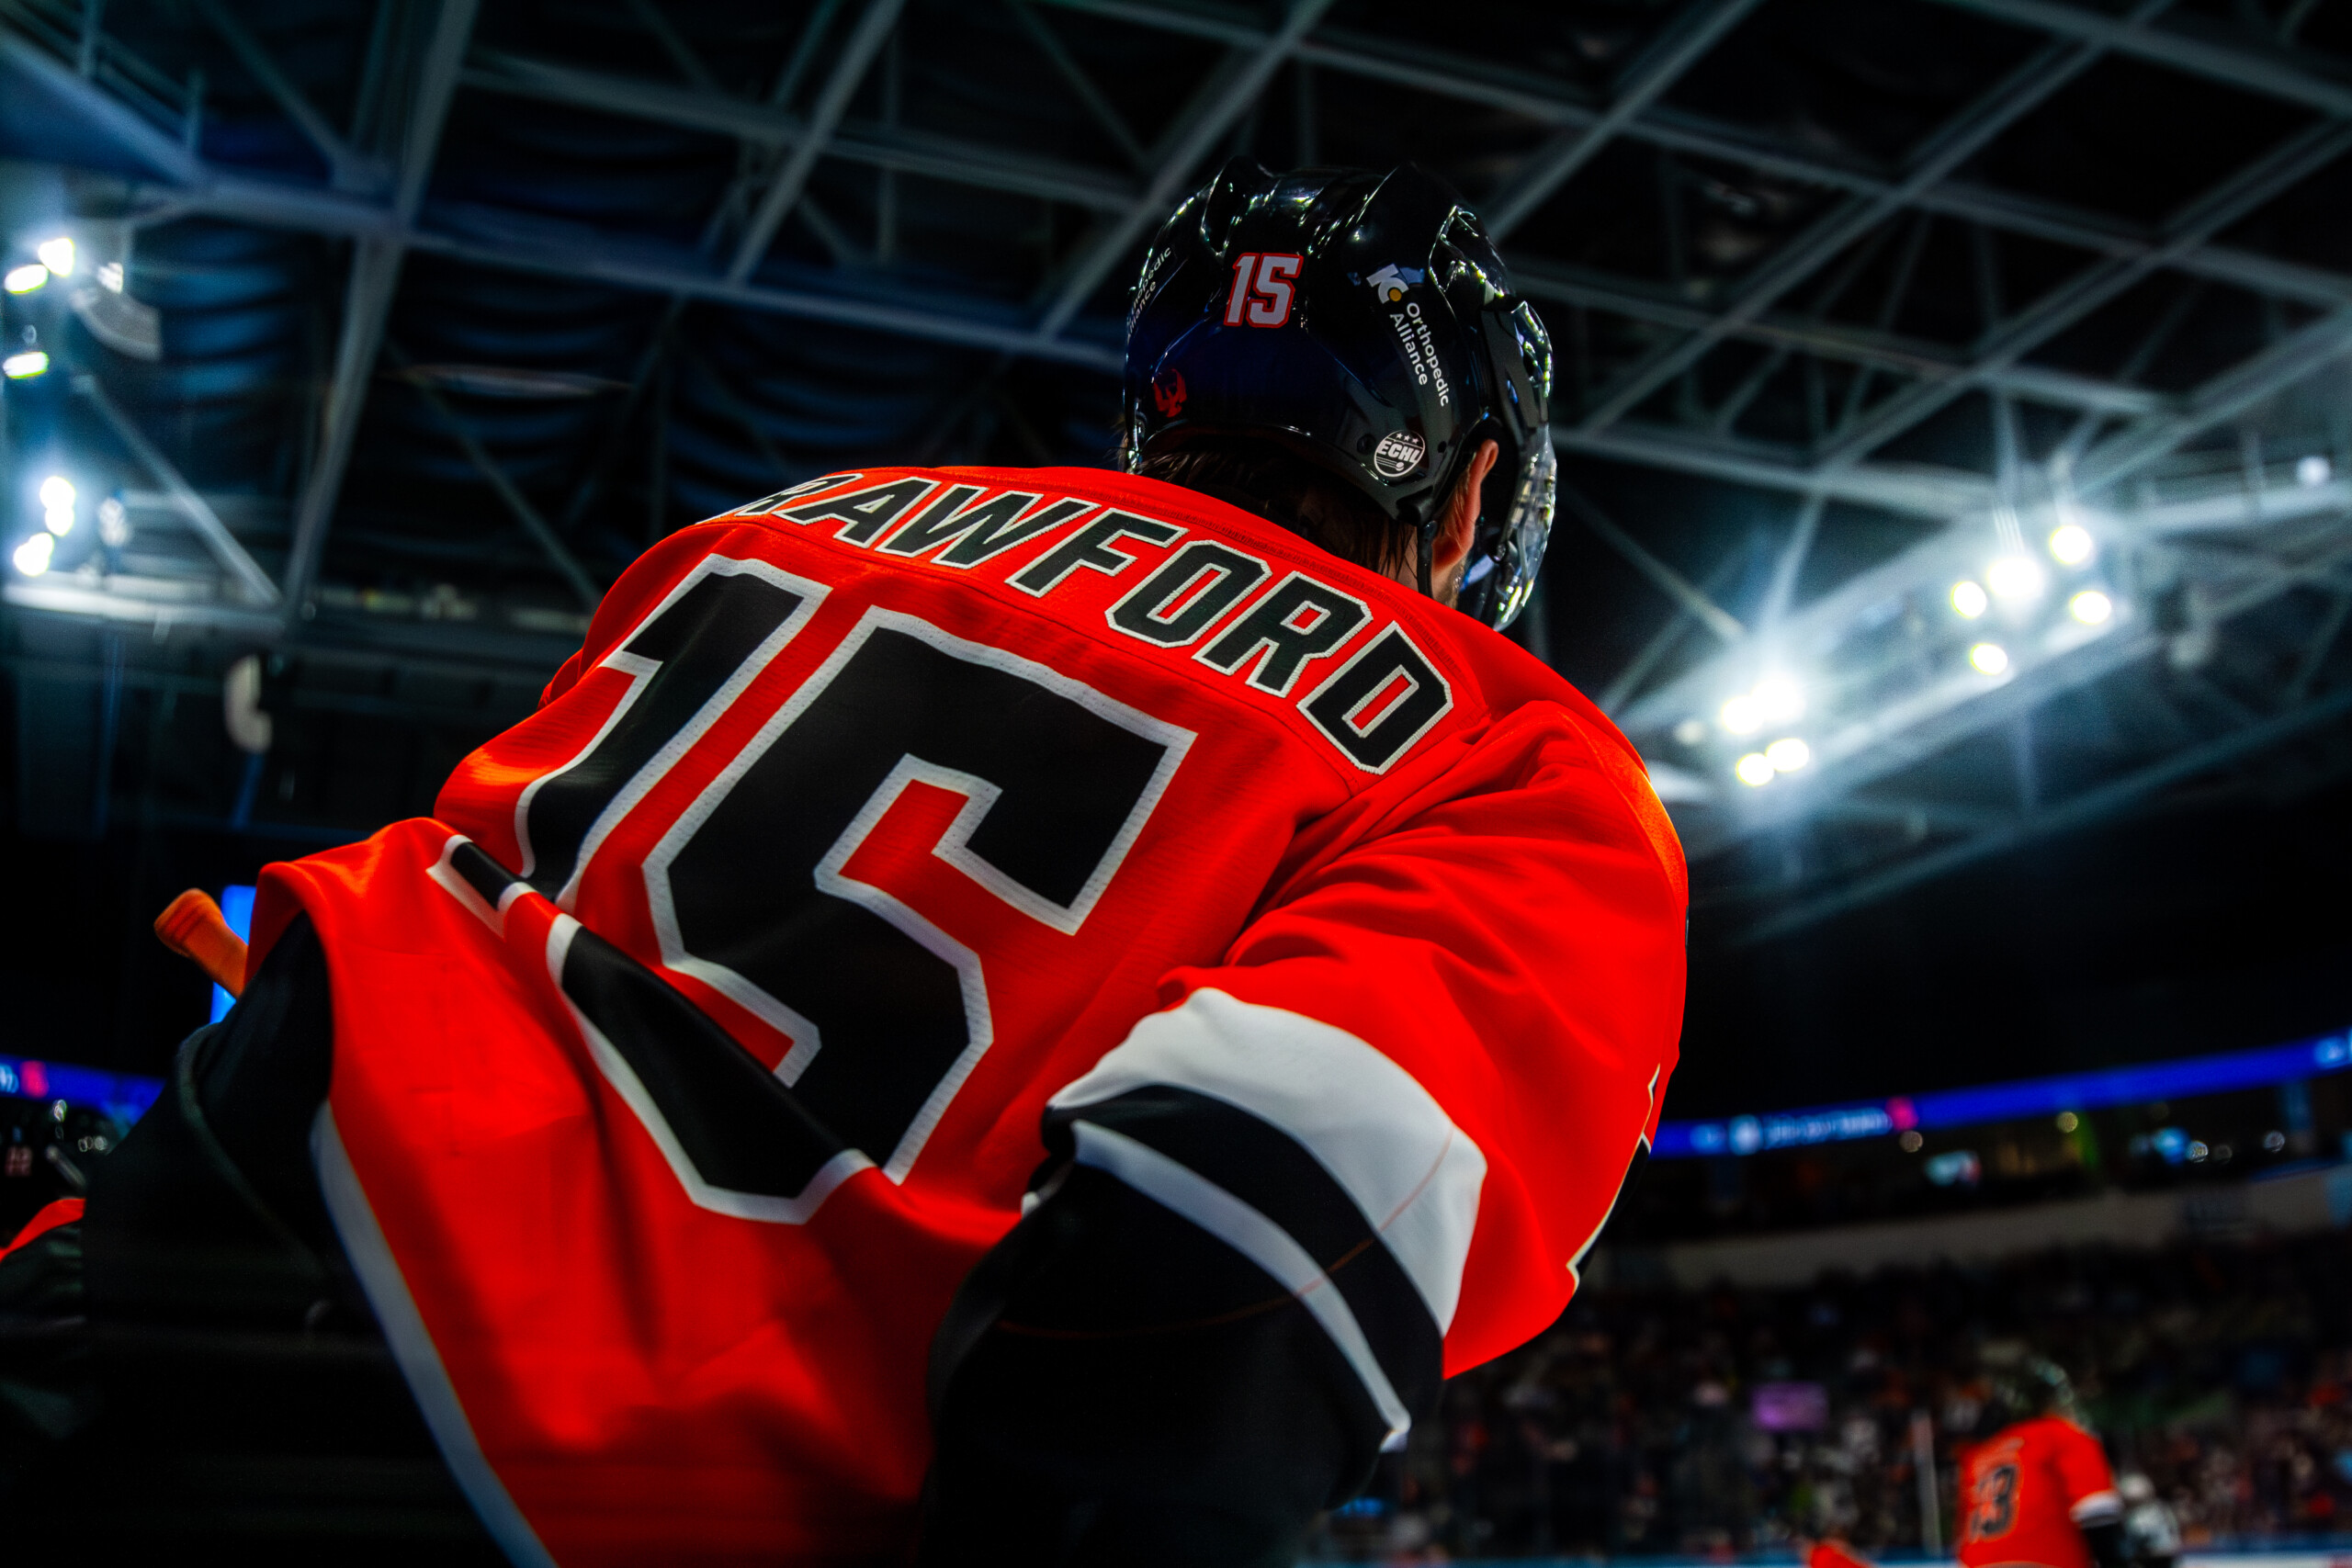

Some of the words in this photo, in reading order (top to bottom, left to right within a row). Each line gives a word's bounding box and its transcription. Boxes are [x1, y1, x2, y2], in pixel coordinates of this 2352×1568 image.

[1223, 252, 1305, 329] 15
[1389, 311, 1429, 387] Alliance
[1407, 301, 1450, 407] Orthopedic
[1376, 439, 1421, 464] ECHL
[425, 552, 1199, 1225] 15
